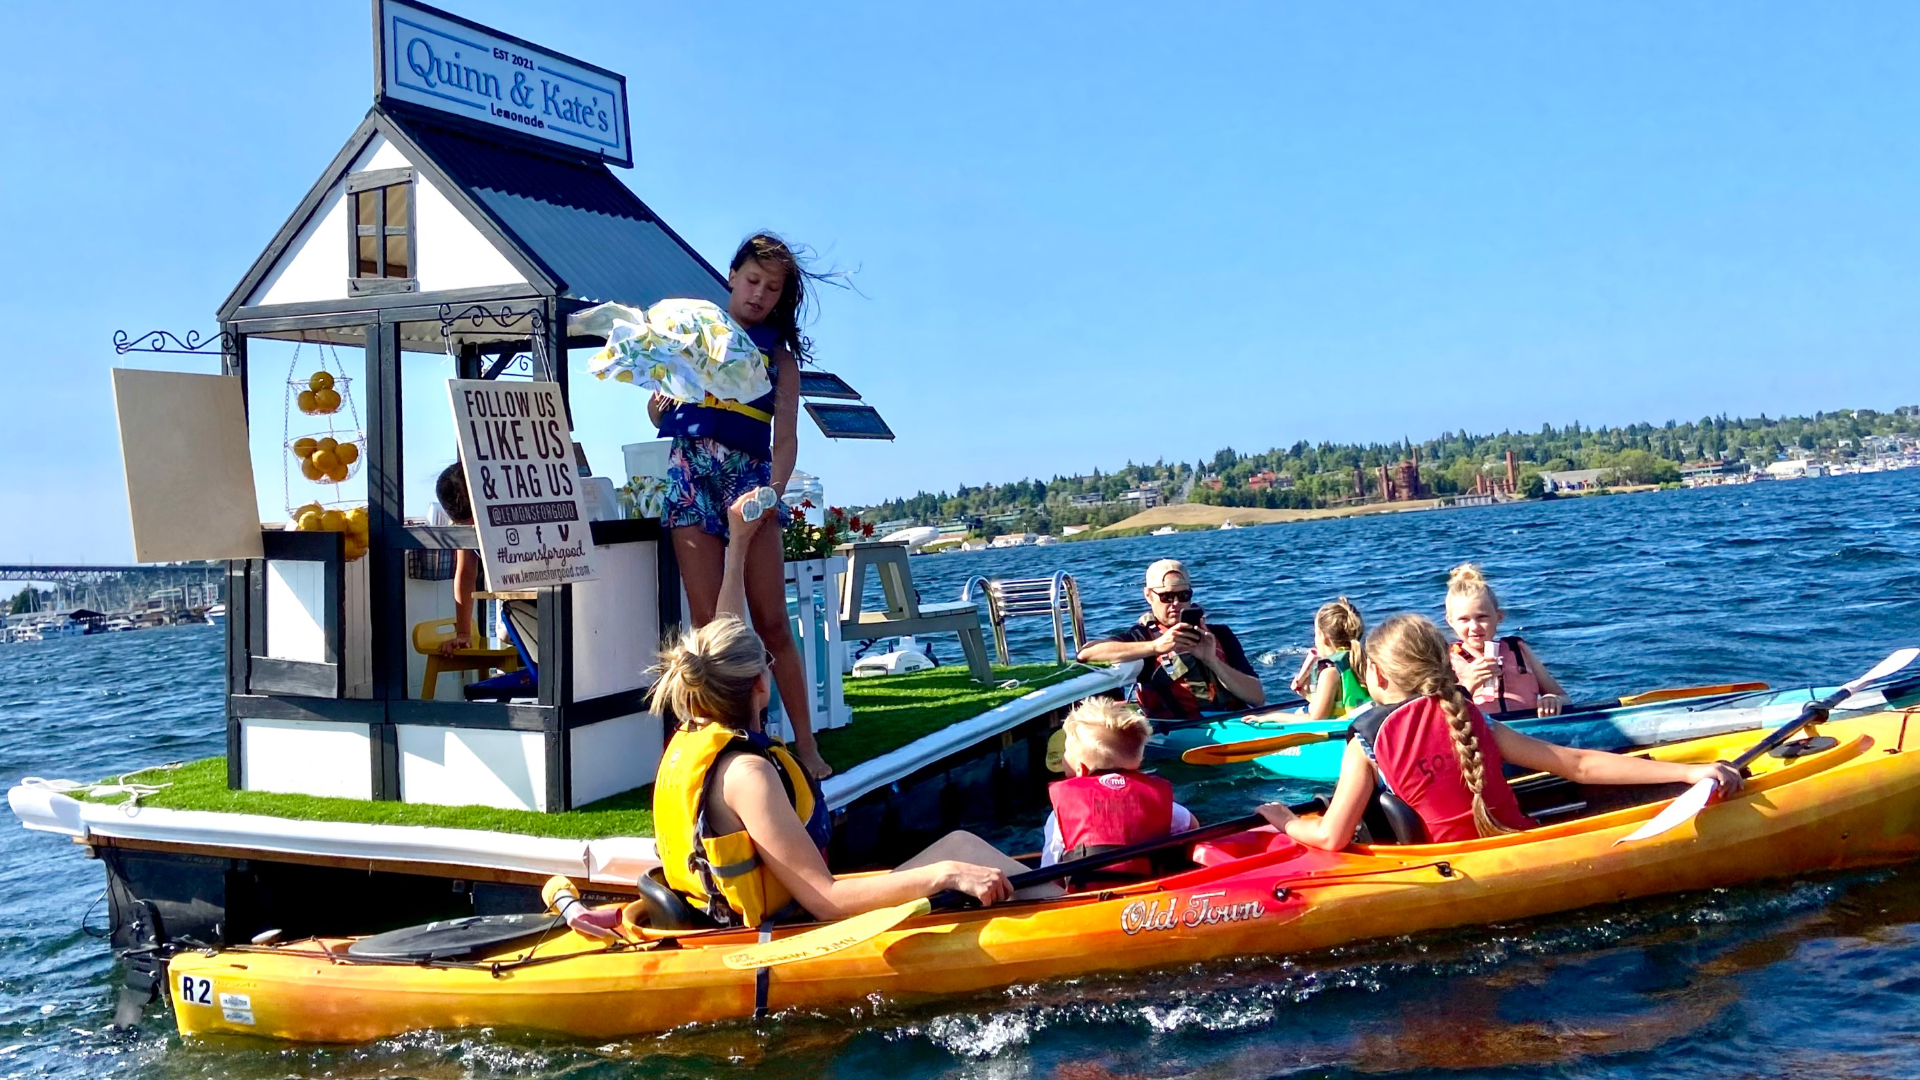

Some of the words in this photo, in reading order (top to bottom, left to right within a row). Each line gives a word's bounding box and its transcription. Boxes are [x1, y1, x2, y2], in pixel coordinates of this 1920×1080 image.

[493, 48, 509, 62] EST
[512, 54, 534, 70] 2021
[407, 37, 502, 101] Quinn
[510, 71, 535, 109] &
[541, 79, 609, 133] Kate's
[490, 102, 545, 129] Lemonade
[464, 390, 530, 418] FOLLOW
[534, 391, 556, 418] US
[470, 420, 529, 461] LIKE
[531, 420, 565, 460] US
[480, 465, 499, 500] &
[500, 464, 543, 499] TAG
[545, 463, 574, 497] US
[492, 503, 575, 525] @LEMONSFORGOOD
[497, 540, 586, 567] #lemonsforgood
[501, 565, 590, 585] www.lemonsforgood.com
[1120, 897, 1178, 935] Old
[1182, 890, 1266, 928] Town
